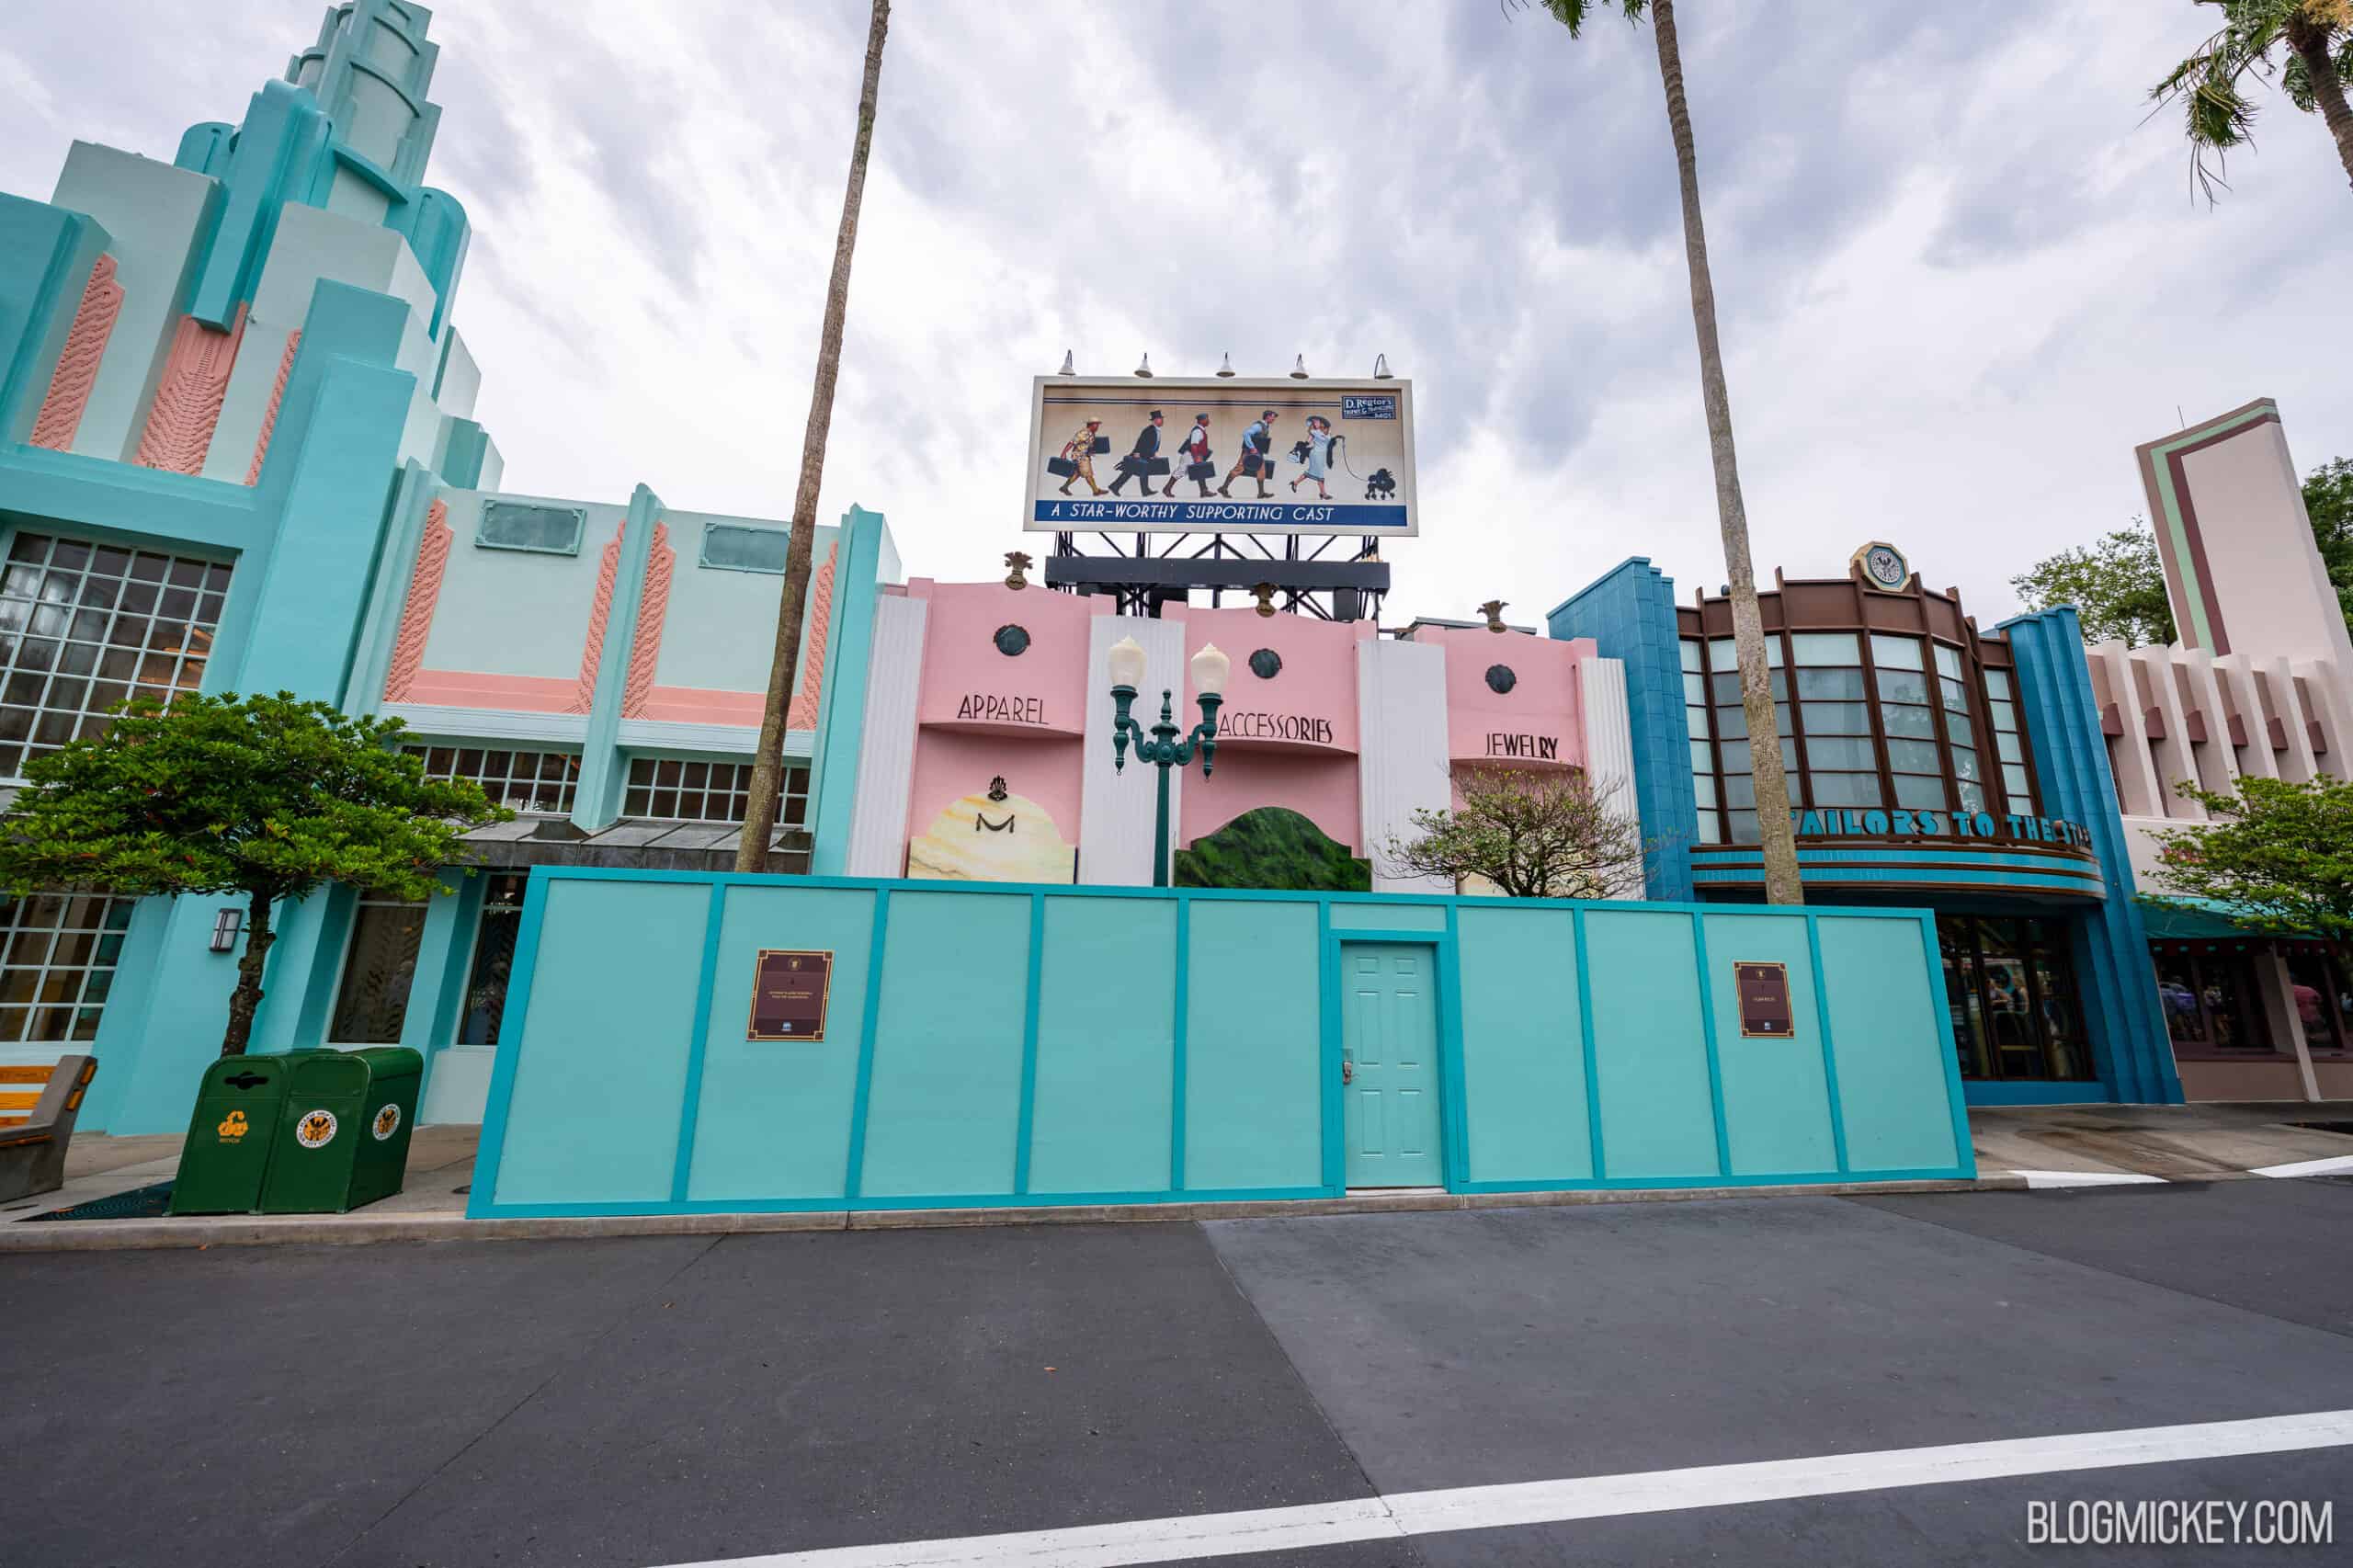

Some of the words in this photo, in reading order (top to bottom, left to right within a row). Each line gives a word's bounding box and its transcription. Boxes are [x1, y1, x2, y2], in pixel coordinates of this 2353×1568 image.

[1051, 503, 1061, 517] A
[1069, 503, 1179, 519] STAR-WORTHY
[1186, 505, 1284, 521] SUPPORTING
[1292, 506, 1336, 521] CAST
[957, 694, 1050, 725] APPAREL
[1218, 712, 1333, 744] ACCESSORIES
[1485, 733, 1559, 759] JEWELRY
[1790, 808, 1938, 835] AILORS
[1950, 811, 1995, 837] TO
[2006, 813, 2053, 842] THE
